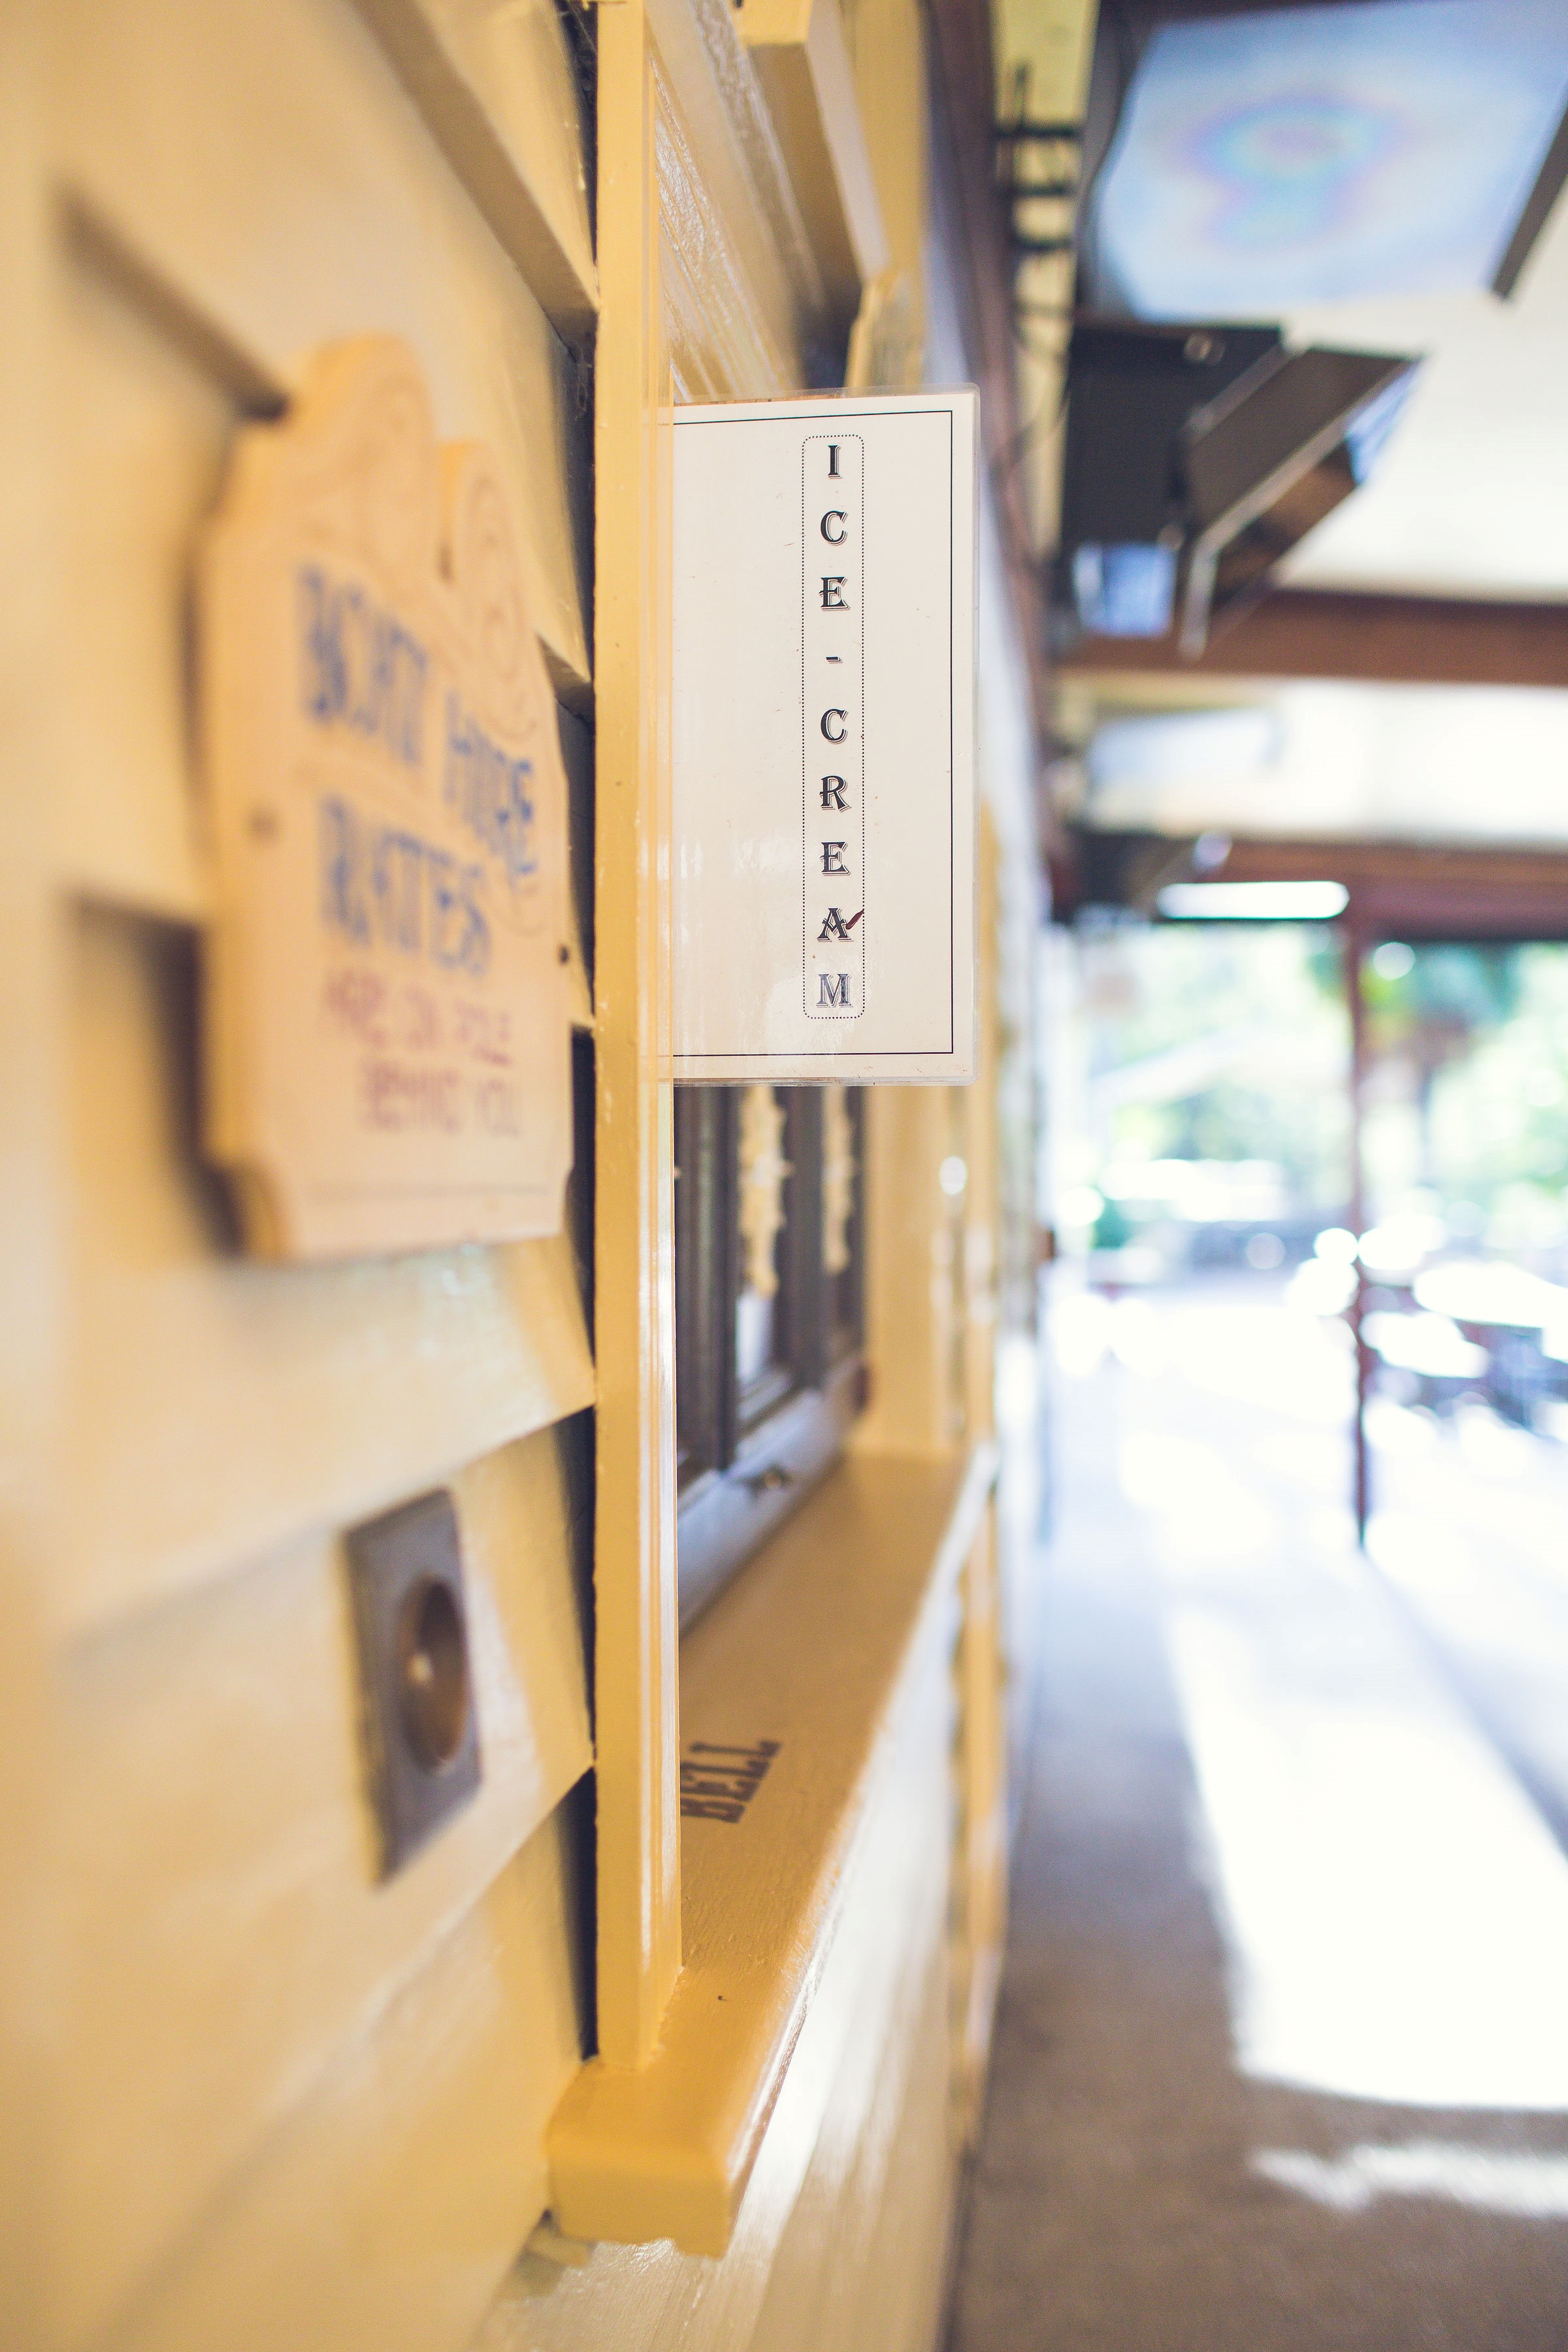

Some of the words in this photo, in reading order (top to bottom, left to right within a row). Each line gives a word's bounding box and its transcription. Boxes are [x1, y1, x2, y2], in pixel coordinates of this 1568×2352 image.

[816, 444, 853, 1009] ICE-CREAM
[317, 796, 491, 977] RATES
[680, 1740, 783, 1823] BELL
